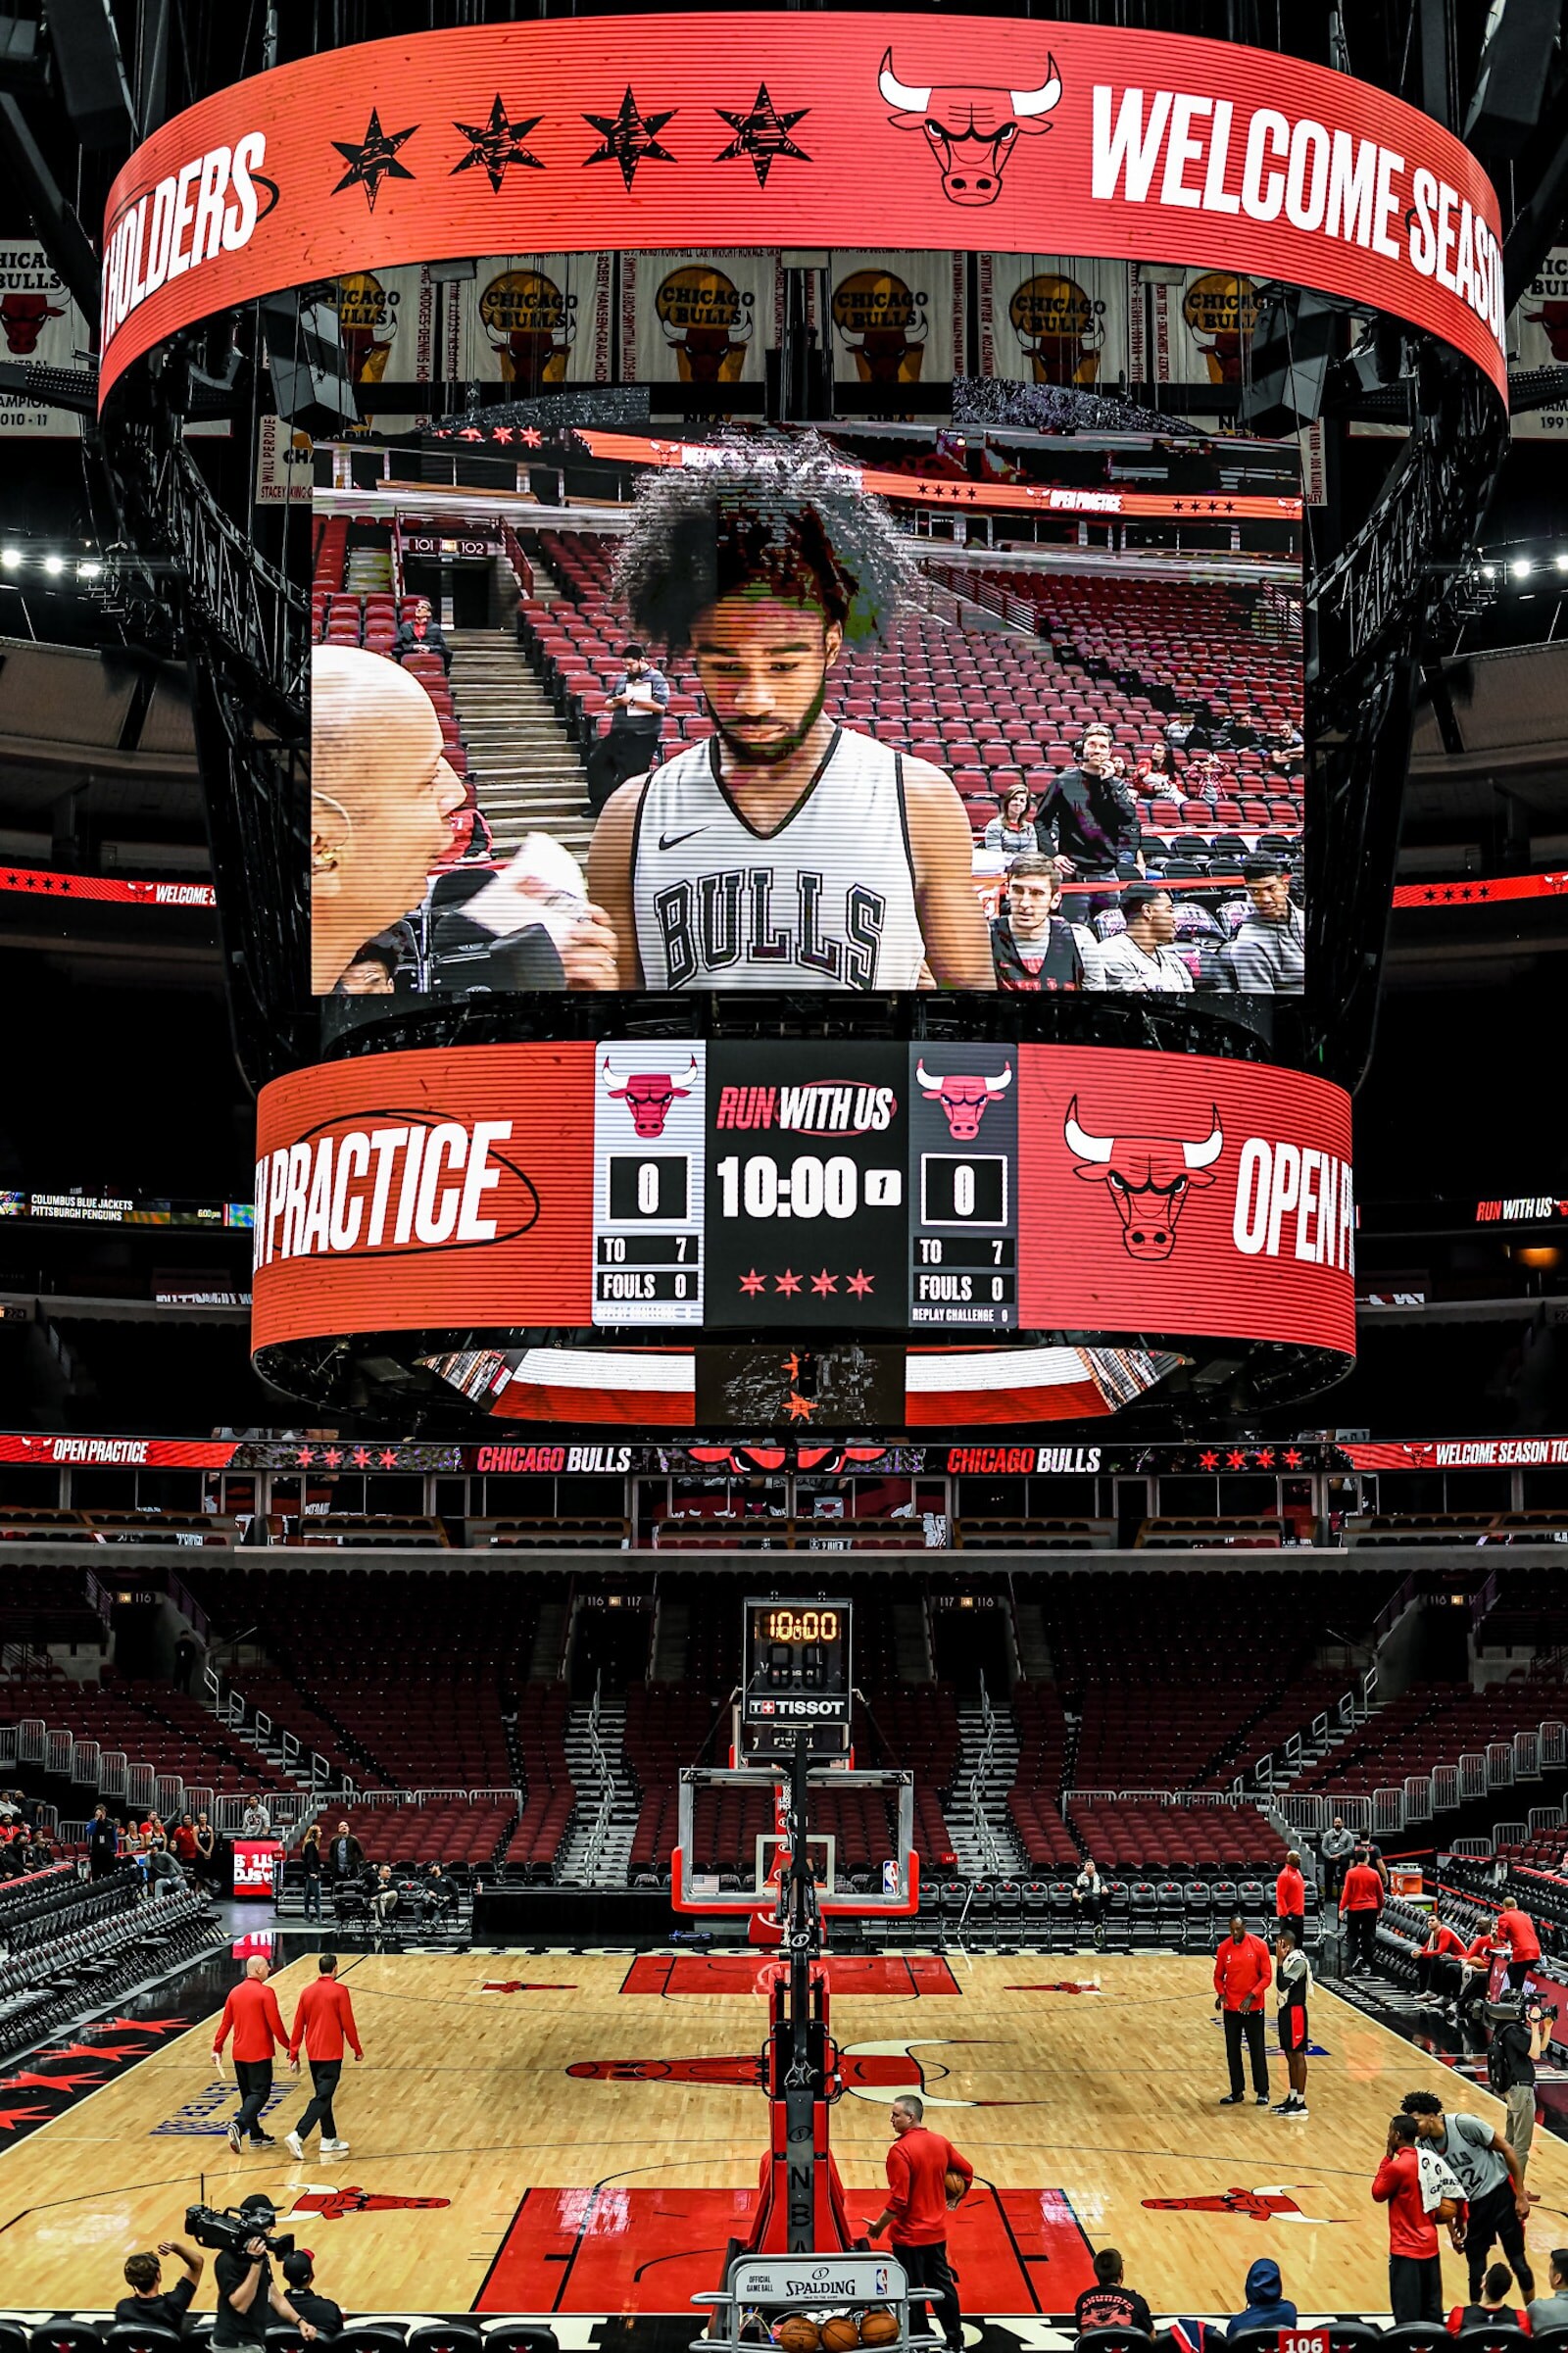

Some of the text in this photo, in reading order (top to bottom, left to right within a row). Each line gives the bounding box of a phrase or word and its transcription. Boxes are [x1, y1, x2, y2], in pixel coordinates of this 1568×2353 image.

[1091, 84, 1406, 261] WELCOME
[105, 131, 266, 347] HOLDERS
[980, 254, 993, 294] WILLIAMS
[487, 292, 578, 309] CHICAGO
[662, 287, 756, 307] CHICAGO
[837, 291, 929, 308] CHICAGO
[1015, 296, 1106, 315] CHICAGO
[500, 312, 567, 328] BULLS
[675, 309, 742, 325] BULLS
[851, 310, 916, 328] BULLS
[981, 297, 993, 323] BRIAN
[1030, 316, 1095, 333] BULLS
[263, 461, 274, 483] WILL
[261, 486, 286, 499] STACEY
[415, 537, 435, 551] 101
[461, 542, 484, 555] 102
[155, 884, 211, 905] WELCOME
[654, 867, 886, 990] BULLS
[716, 1086, 894, 1130] RUN WITH US
[266, 1120, 514, 1264] PRACTICE
[637, 1162, 660, 1215] 0
[716, 1155, 858, 1218] 10:00
[954, 1164, 975, 1216] 0
[31, 1194, 133, 1211] COLUMBUS BLUE JACKETS
[1233, 1137, 1339, 1267] OPEN
[1476, 1197, 1553, 1221] RUN WITH US
[31, 1205, 122, 1222] PITTSBURGH PENGUINS
[604, 1238, 687, 1263] TO 7
[919, 1239, 1004, 1265] TO 7
[603, 1274, 687, 1299] FOULS 0
[919, 1275, 1004, 1301] FOULS 0
[912, 1307, 1008, 1322] REPLAY CHALLENGE 0
[53, 1439, 149, 1463] OPEN PRACTICE
[476, 1446, 632, 1472] CHICAGO BULLS
[947, 1447, 1102, 1473] CHICAGO BULLS
[1436, 1444, 1498, 1465] WELCOME
[1497, 1441, 1549, 1463] SEASON
[135, 1593, 152, 1604] 116
[587, 1595, 604, 1606] 116
[626, 1595, 642, 1606] 117
[940, 1596, 955, 1607] 117
[769, 1611, 837, 1640] 10:00
[775, 1700, 845, 1715] TISSOT
[786, 2279, 856, 2297] SPALDING
[1285, 2337, 1324, 2353] 106
